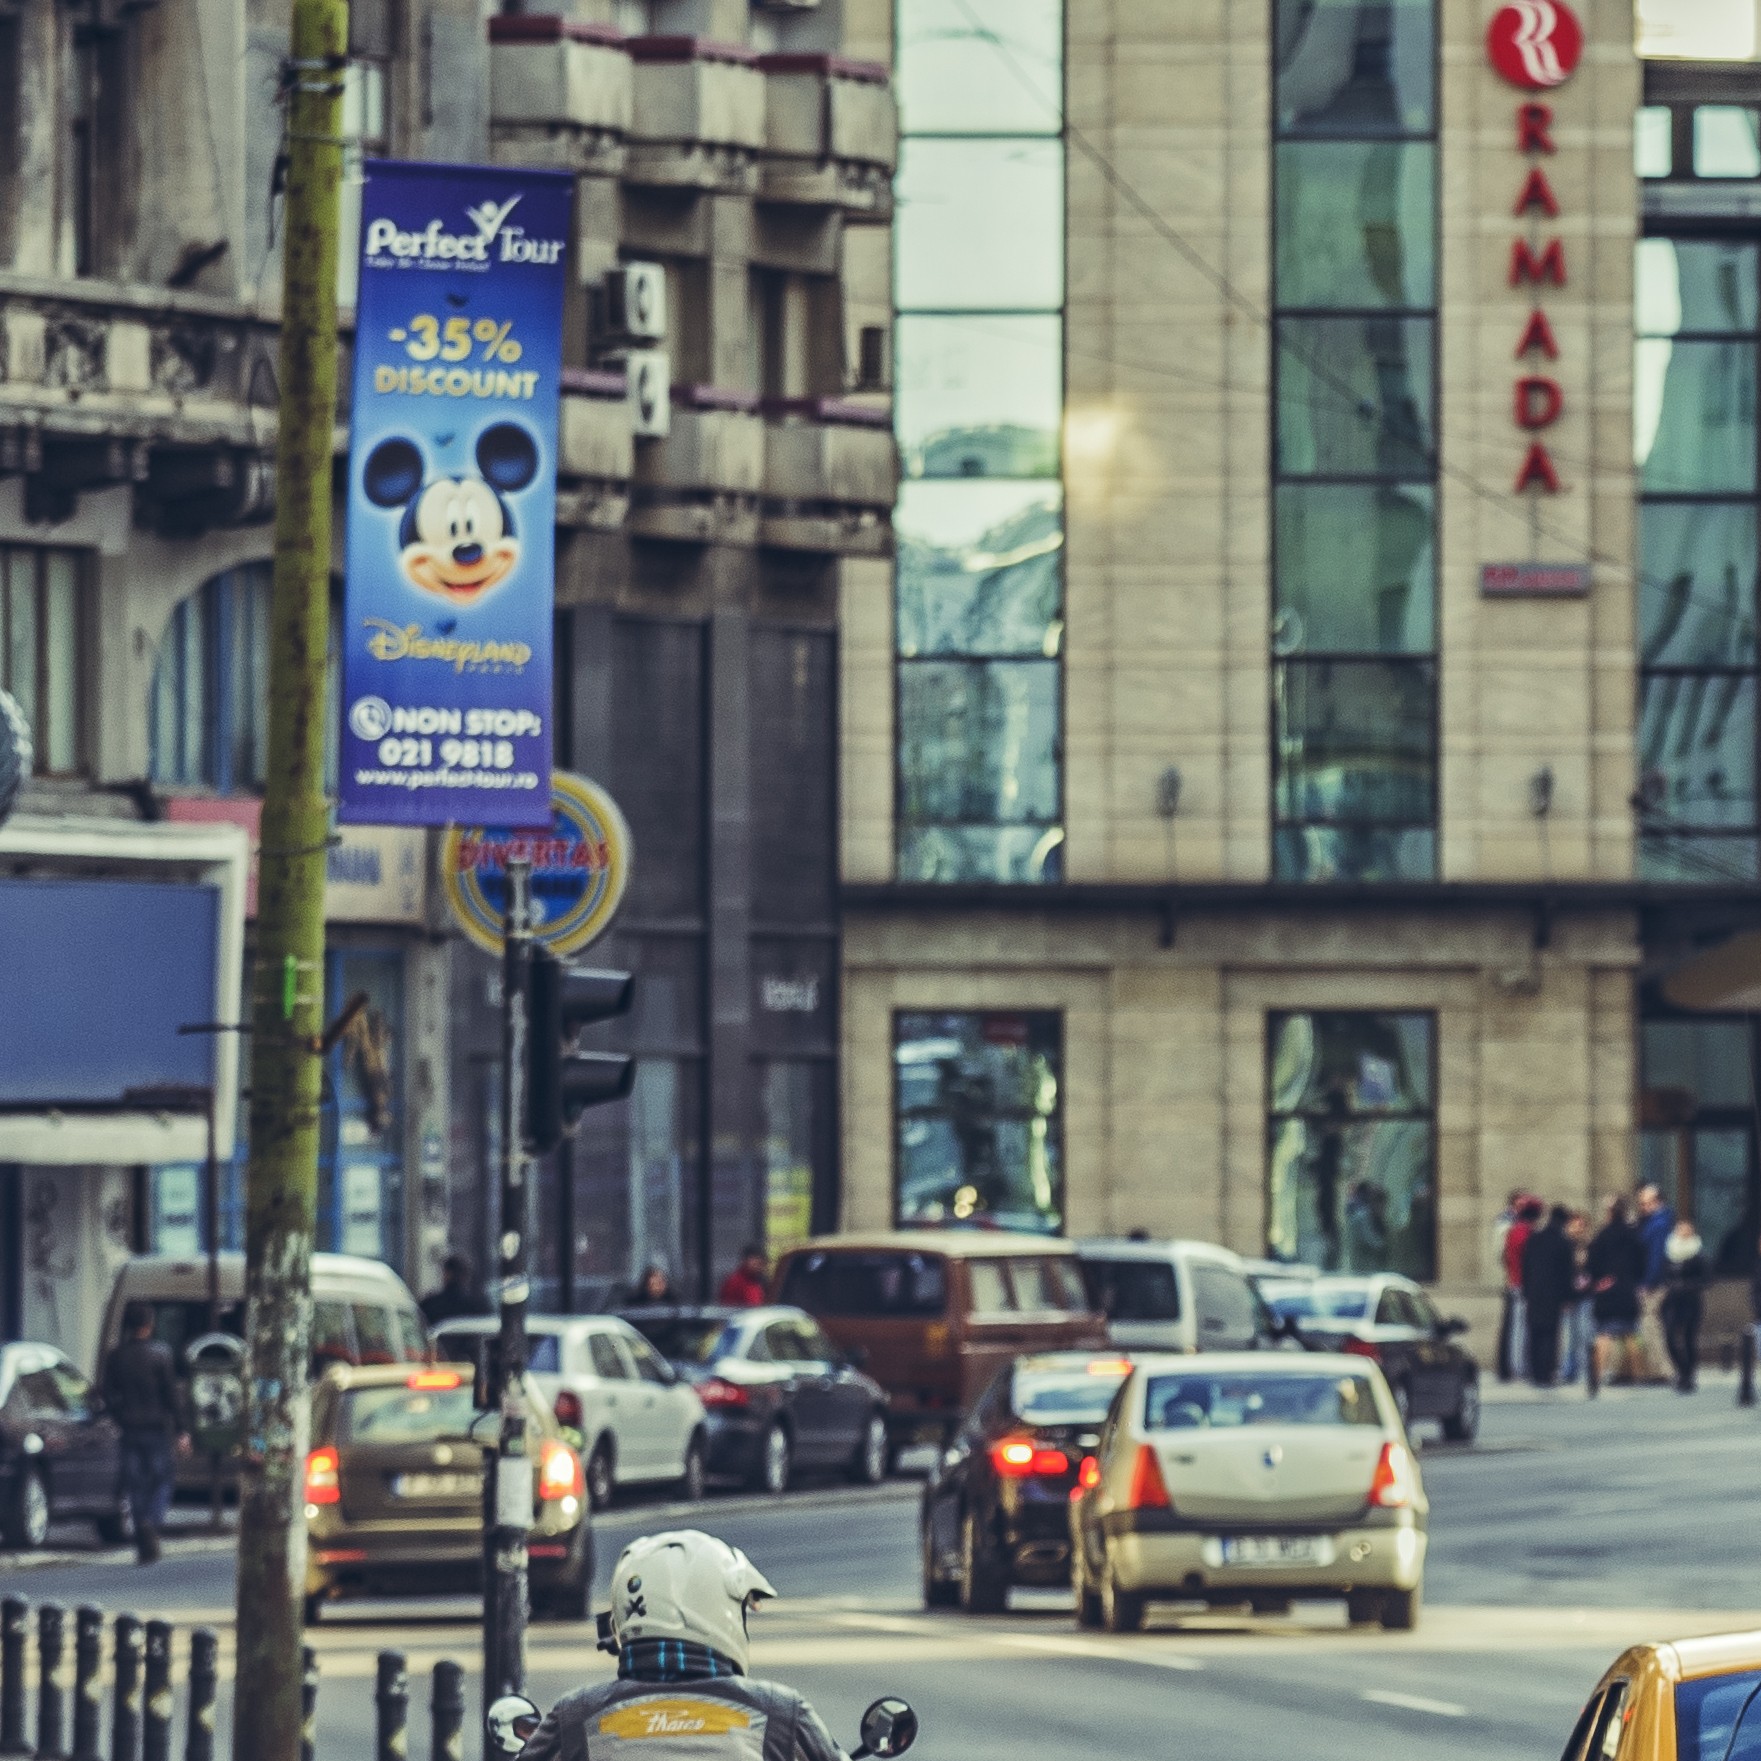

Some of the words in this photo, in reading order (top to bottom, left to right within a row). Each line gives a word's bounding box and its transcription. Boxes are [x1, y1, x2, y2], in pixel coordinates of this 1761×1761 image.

[366, 217, 489, 262] Perfect
[499, 225, 566, 265] Tour
[1507, 103, 1568, 494] RAMADA
[388, 313, 523, 364] -35%
[374, 365, 540, 400] DISCOUNT
[392, 706, 463, 736] NON
[378, 737, 433, 768] 021
[439, 737, 515, 771] 9818
